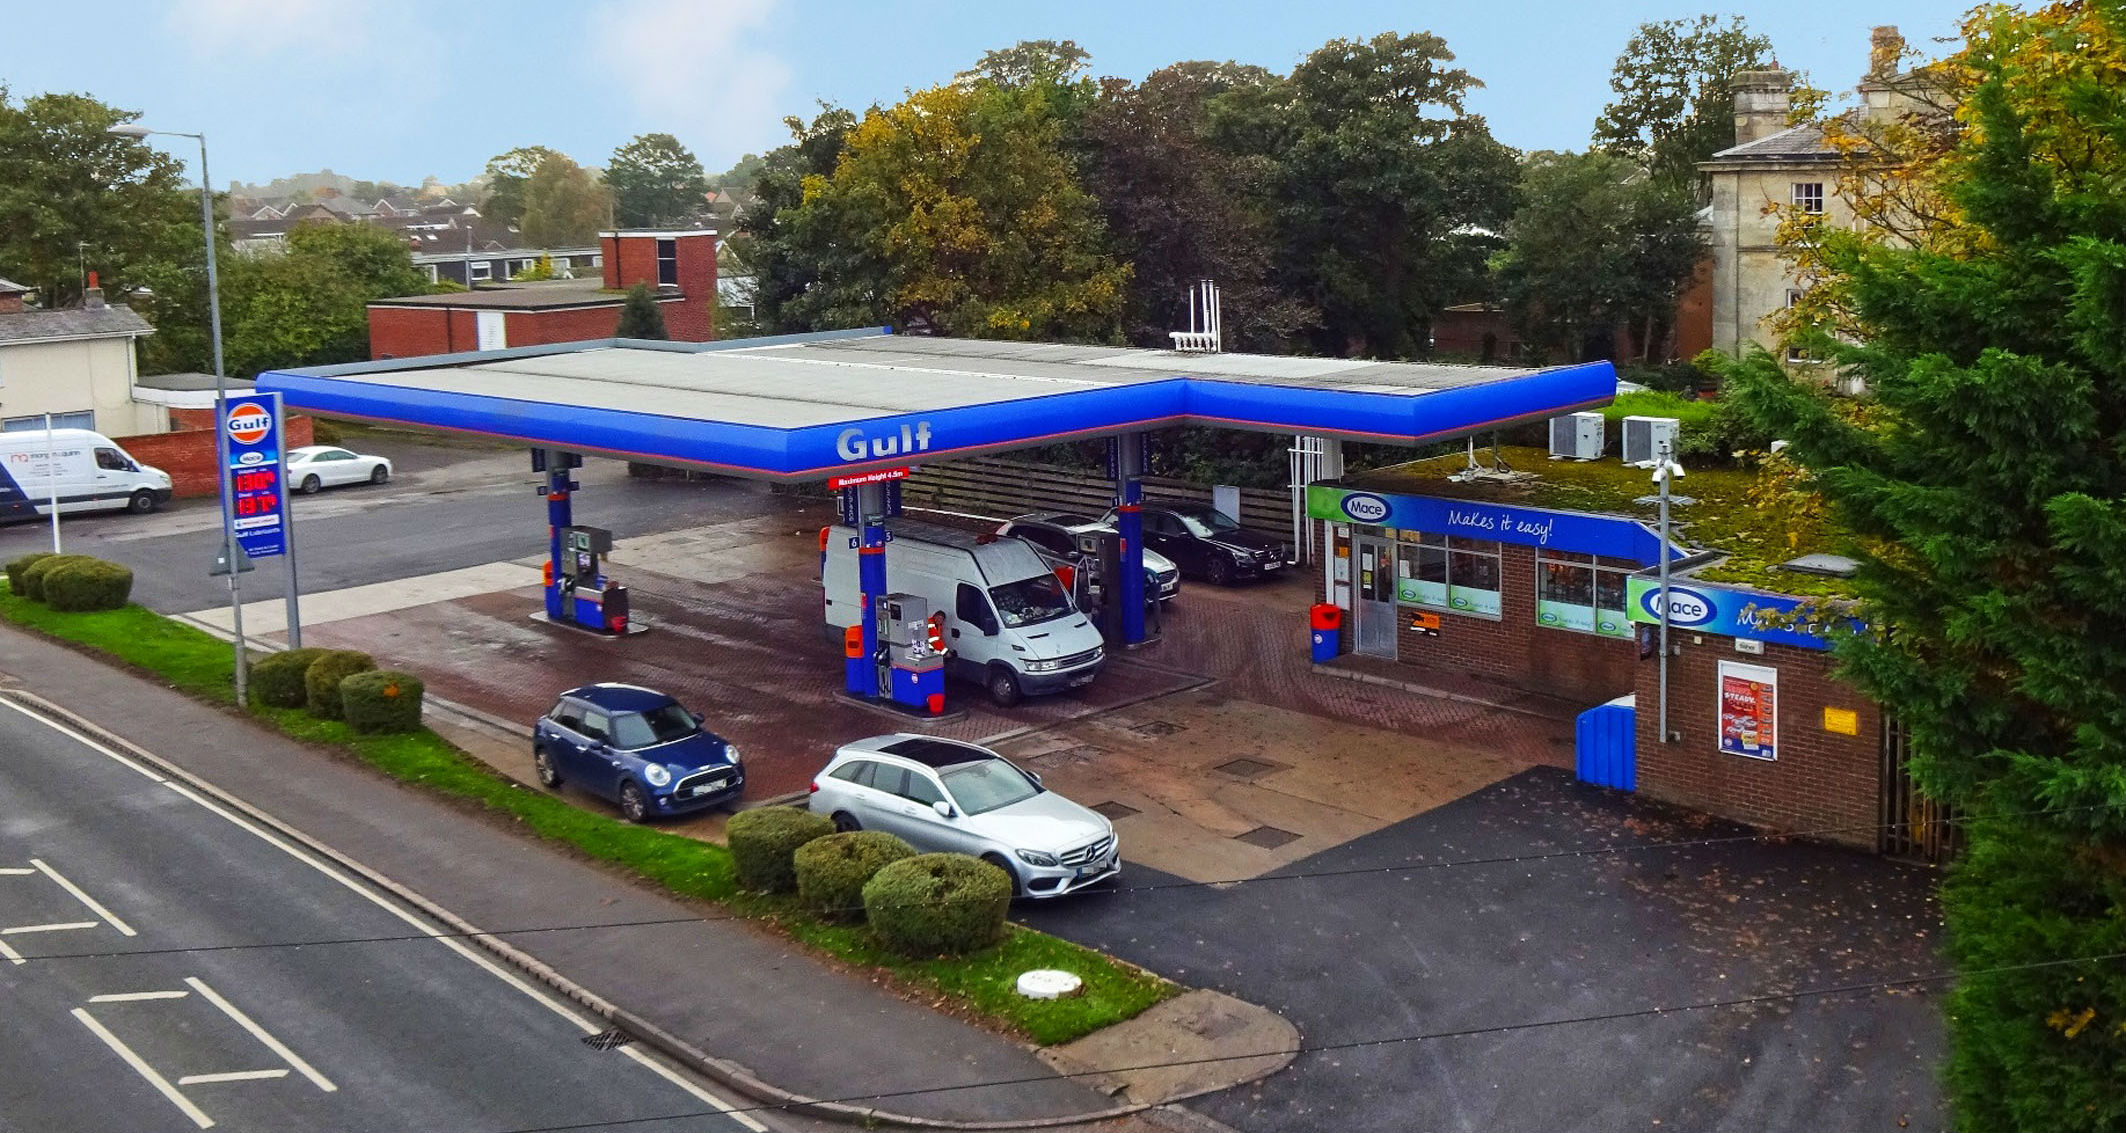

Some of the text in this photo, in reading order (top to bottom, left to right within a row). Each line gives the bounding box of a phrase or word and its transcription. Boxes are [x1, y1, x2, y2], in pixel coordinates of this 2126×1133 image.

[229, 417, 269, 430] Gulf
[837, 421, 932, 462] Gulf
[838, 470, 904, 487] Maximum Height 4.5m
[1350, 500, 1383, 516] Mace
[1447, 510, 1553, 544] Makes it easy!
[851, 538, 857, 547] 6
[885, 532, 891, 541] 5
